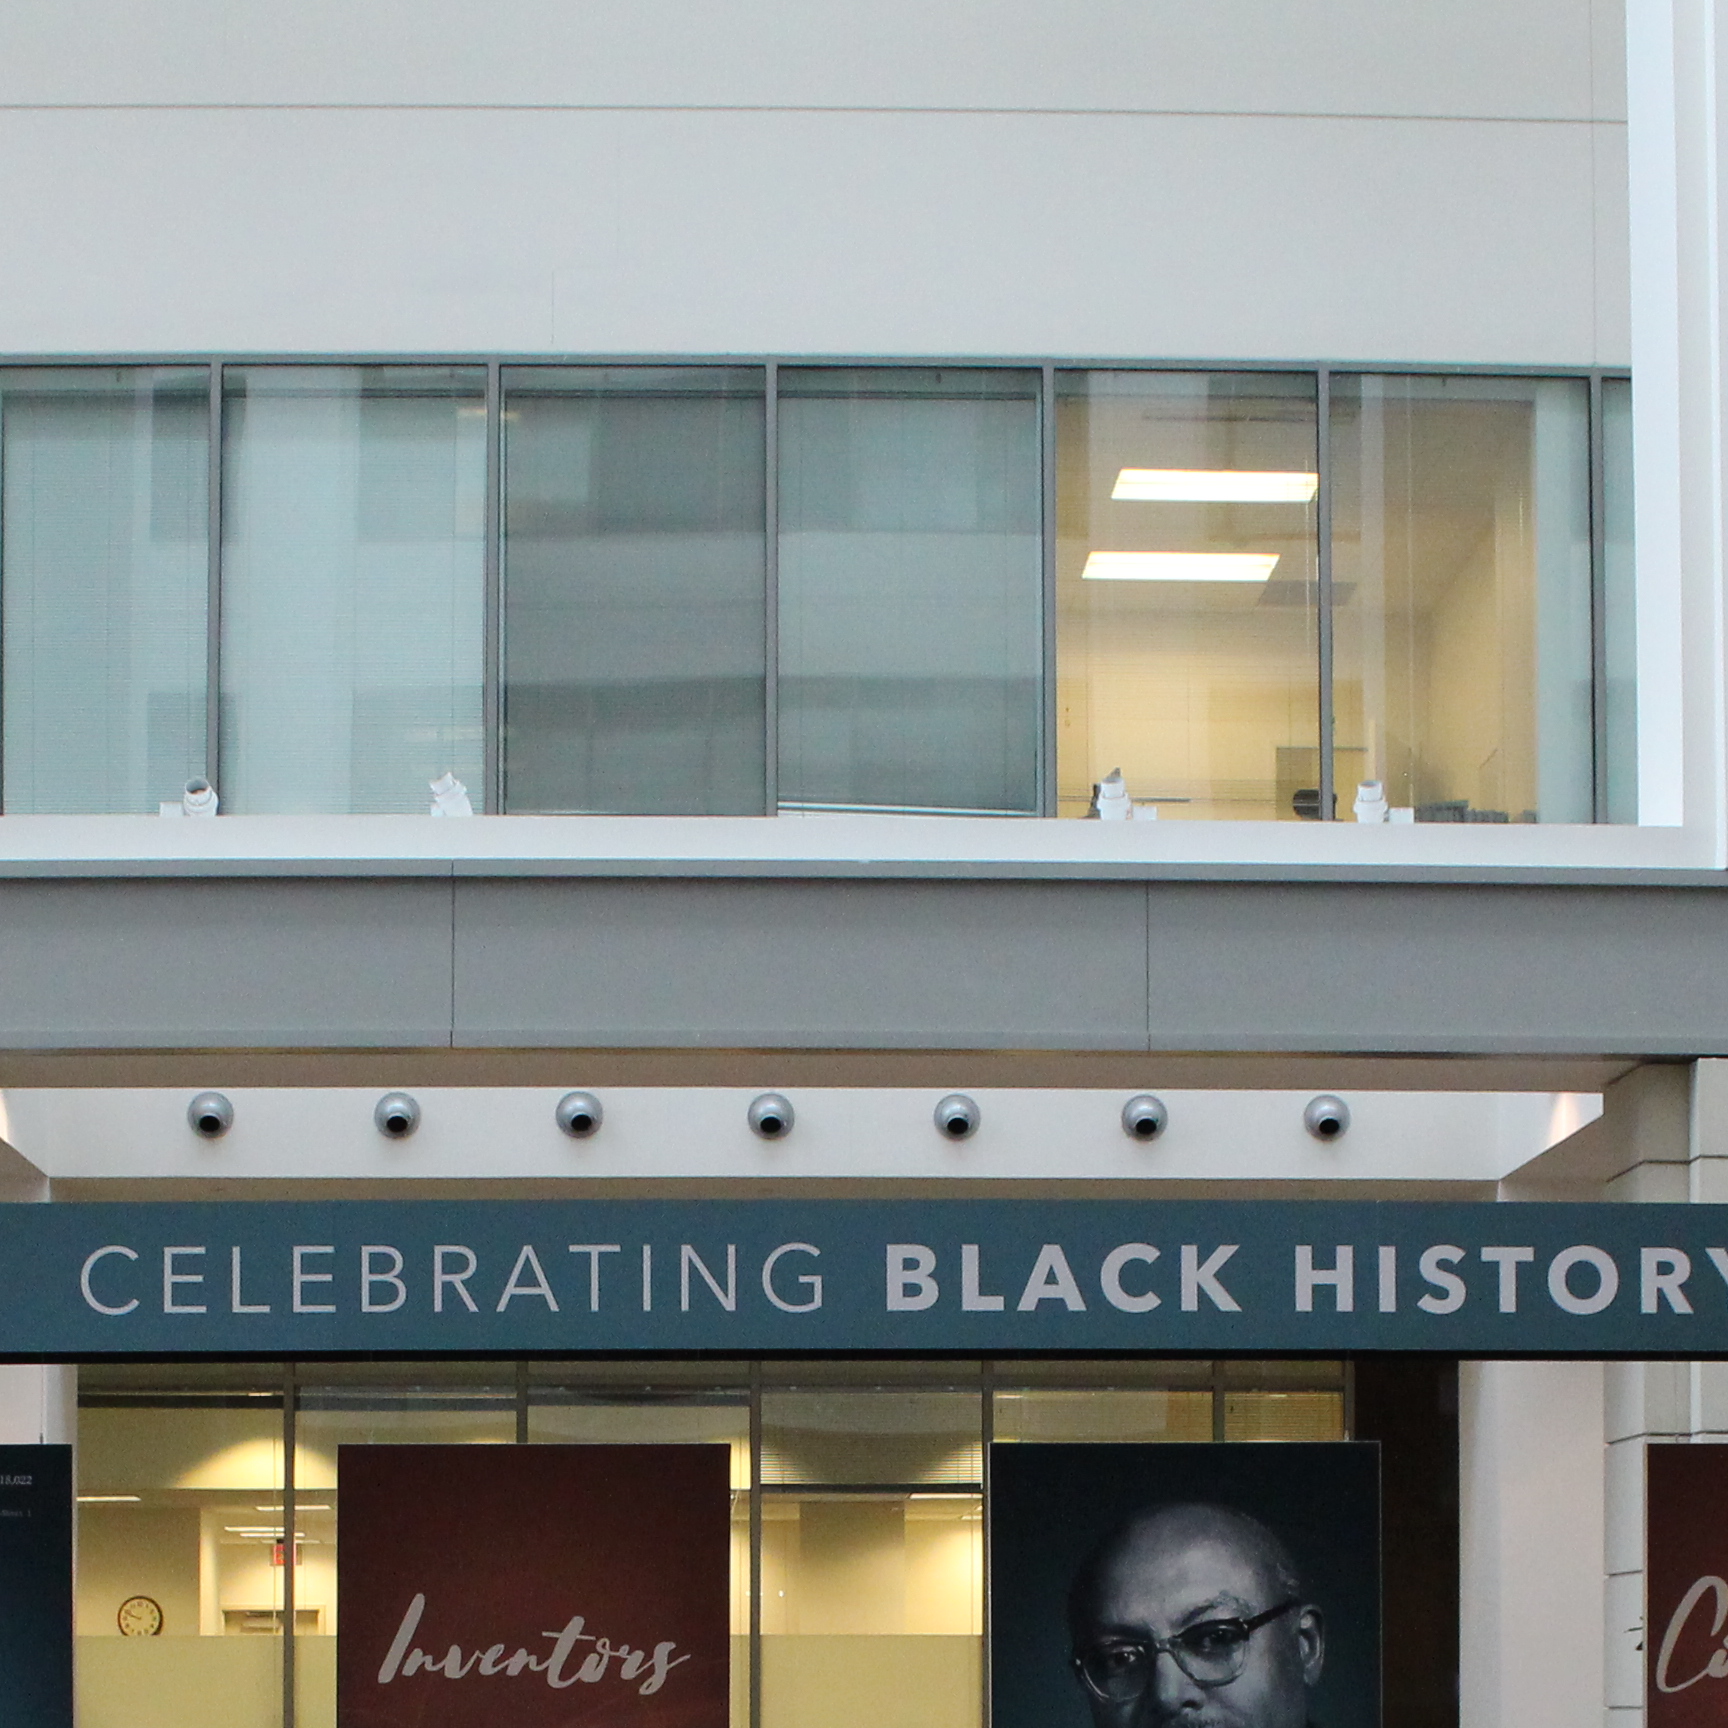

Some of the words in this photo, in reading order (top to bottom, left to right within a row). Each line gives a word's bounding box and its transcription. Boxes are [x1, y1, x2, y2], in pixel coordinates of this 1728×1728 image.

[79, 1242, 826, 1317] CELEBRATING
[885, 1242, 1245, 1314] BLACK
[377, 1593, 691, 1695] Inventors
